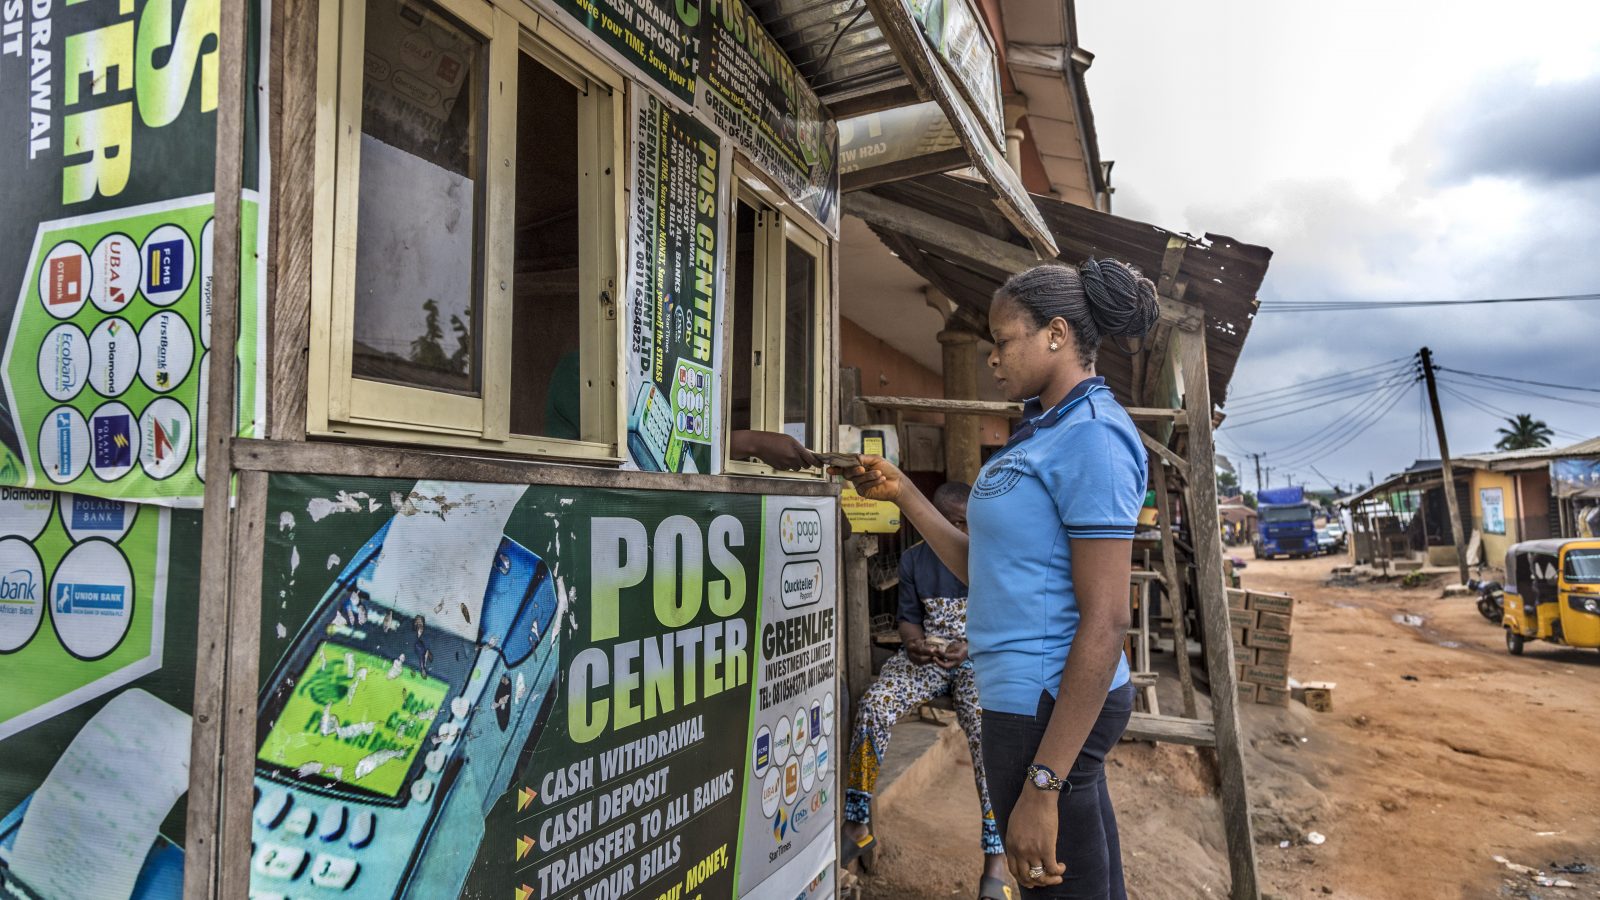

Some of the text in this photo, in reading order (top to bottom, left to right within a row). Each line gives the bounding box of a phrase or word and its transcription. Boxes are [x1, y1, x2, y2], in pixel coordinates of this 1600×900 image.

[601, 13, 622, 38] your
[624, 28, 646, 61] TIME,
[648, 50, 667, 74] Save
[636, 13, 680, 61] DEPOSIT
[719, 40, 734, 60] CASH
[720, 28, 735, 49] CASH
[717, 65, 729, 82] PAY
[638, 108, 647, 136] TEL:
[640, 93, 657, 377] GREENLIFE INVESTMENT LTD.
[677, 208, 682, 223] TO
[689, 187, 697, 267] WITHDRAWAL
[109, 242, 121, 281] UBA
[693, 140, 717, 362] POS CENTER
[62, 333, 74, 391] Ecobank
[160, 315, 169, 370] FirstBank
[655, 346, 663, 383] STRESS
[83, 513, 112, 522] BANK
[796, 521, 818, 544] paga
[75, 592, 121, 601] UNION BANK
[591, 514, 747, 642] POS
[784, 578, 813, 594] Quickteller
[762, 607, 833, 660] GREENLIFE
[568, 618, 748, 743] CENTER
[765, 642, 831, 682] INVESTMENTS LIMITED
[759, 686, 771, 711] TEL:
[541, 715, 704, 805] CASH WITHDRAWAL
[539, 766, 669, 852] CASH DEPOSIT
[538, 768, 734, 900] TRANSFER TO ALL BANKS
[769, 841, 792, 863] StarTimes
[640, 835, 681, 885] BILLS
[685, 843, 729, 894] MONEY,
